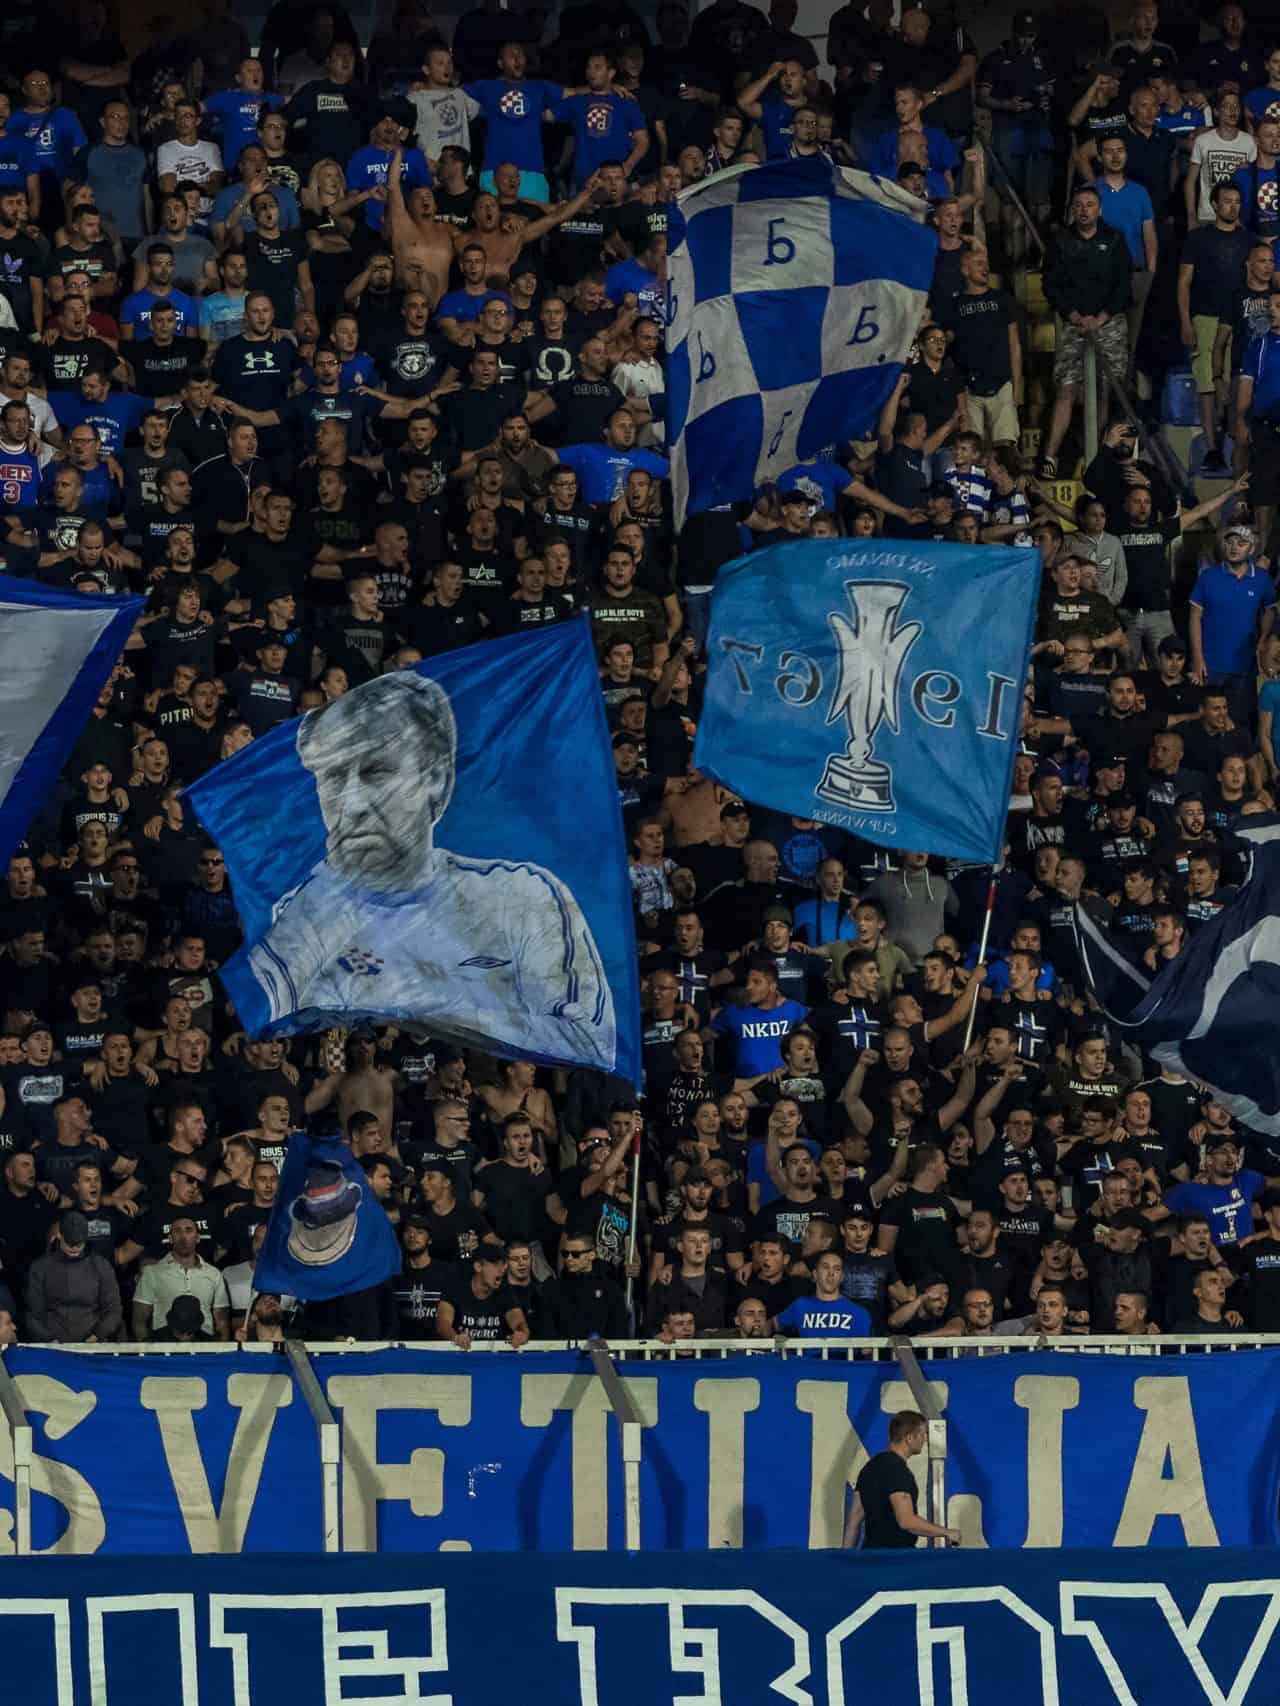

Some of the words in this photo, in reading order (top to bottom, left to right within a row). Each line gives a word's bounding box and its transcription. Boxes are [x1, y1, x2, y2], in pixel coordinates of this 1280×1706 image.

[366, 162, 409, 175] PRVCI
[3, 482, 21, 504] 3
[594, 609, 610, 619] BAD
[611, 609, 627, 619] BLUE
[628, 609, 644, 619] BOYS
[741, 1020, 791, 1039] NKDZ
[802, 1312, 853, 1330] NKDZ
